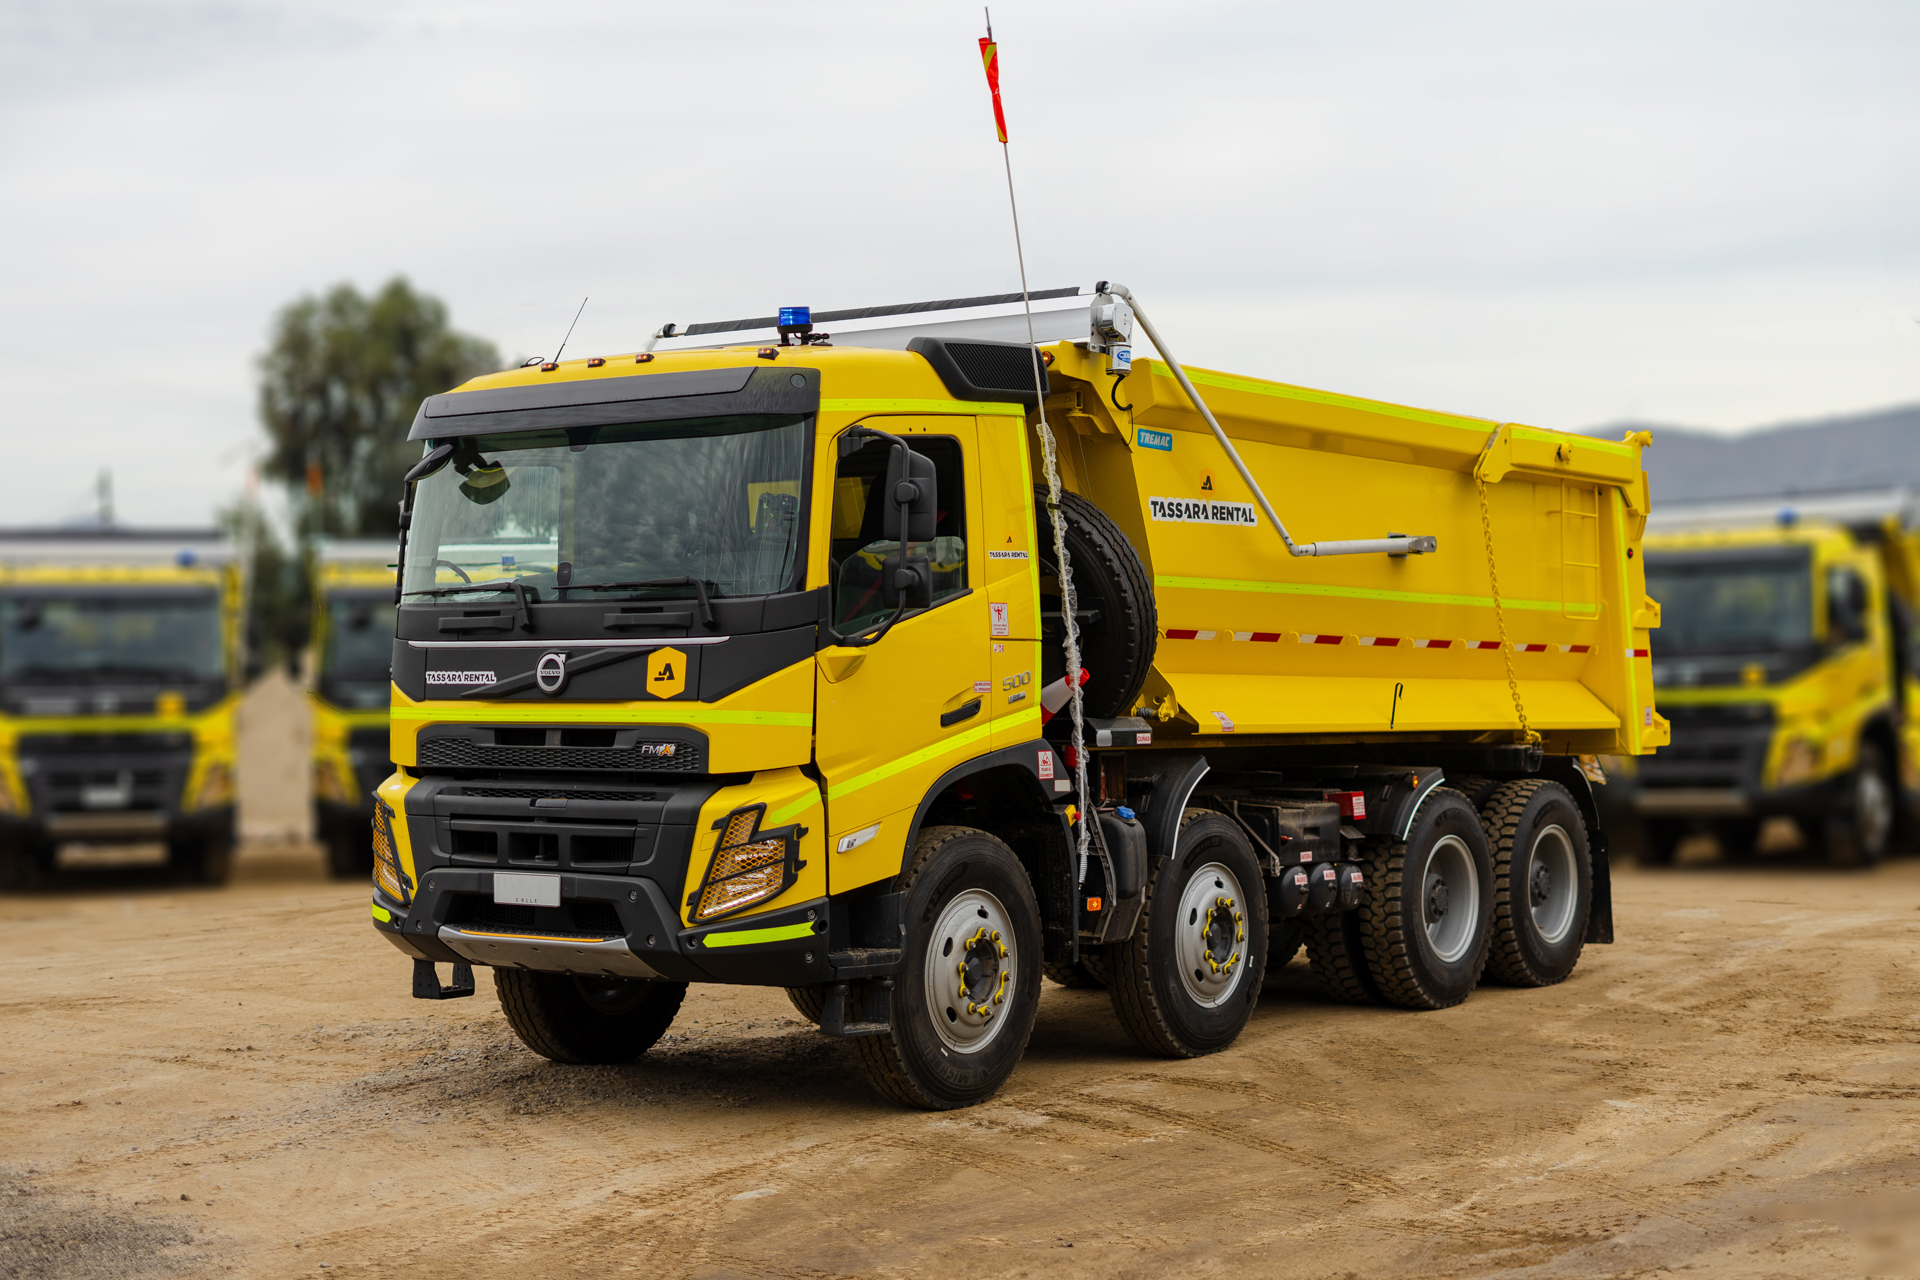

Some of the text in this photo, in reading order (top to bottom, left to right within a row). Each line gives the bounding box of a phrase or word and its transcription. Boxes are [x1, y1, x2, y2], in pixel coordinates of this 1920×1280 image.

[1140, 432, 1171, 447] TREMAC
[1151, 500, 1255, 523] TASSARA RENTAL
[427, 673, 495, 682] TASSARA RENTAL
[1002, 670, 1031, 691] 500
[641, 743, 677, 757] FMX
